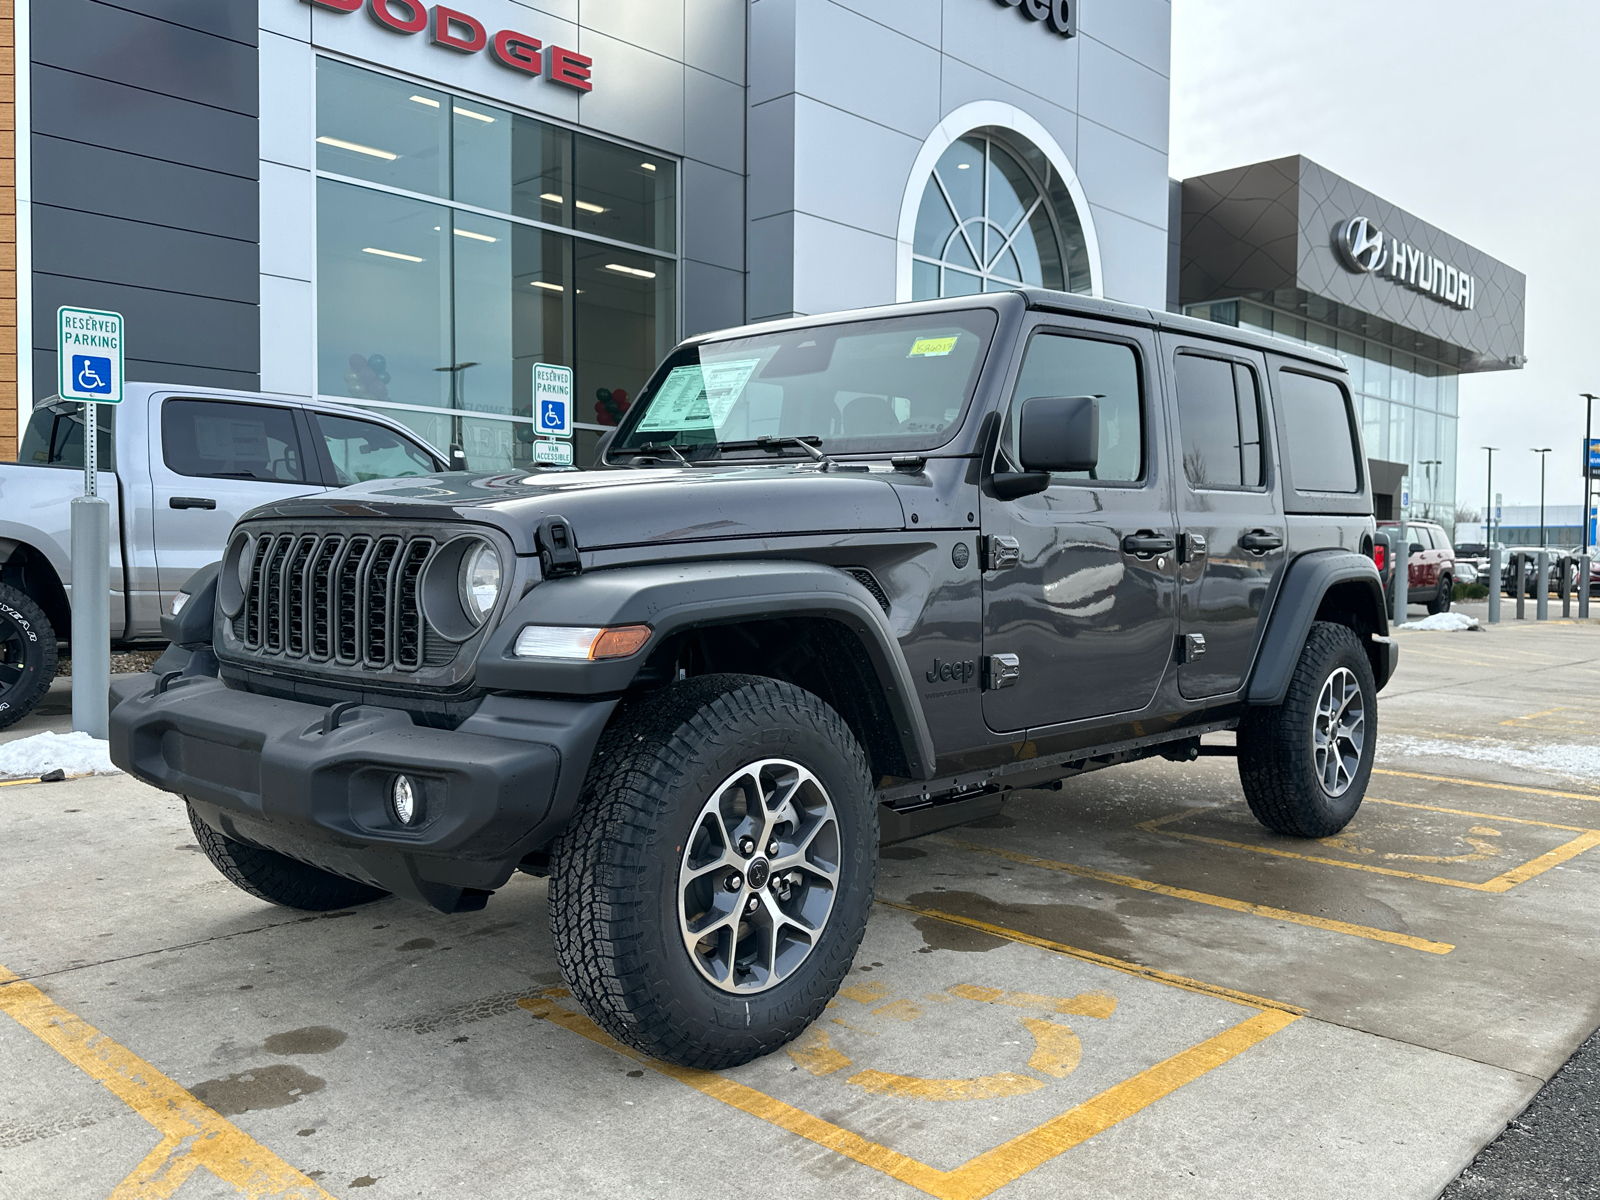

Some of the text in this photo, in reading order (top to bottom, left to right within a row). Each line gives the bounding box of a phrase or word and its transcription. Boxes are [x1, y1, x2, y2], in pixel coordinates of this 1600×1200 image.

[1391, 238, 1475, 310] HYUNDAI
[65, 316, 117, 333] RESERVED
[65, 332, 117, 349] PARKING
[537, 370, 569, 384] RESERVED
[537, 383, 569, 396] PARKING
[536, 453, 570, 462] ACCESSIBLE
[548, 445, 559, 453] VAN
[0, 603, 37, 642] YEAR
[926, 657, 975, 684] Jeep
[924, 687, 969, 700] WRANGLER
[696, 727, 801, 793] NEXEN
